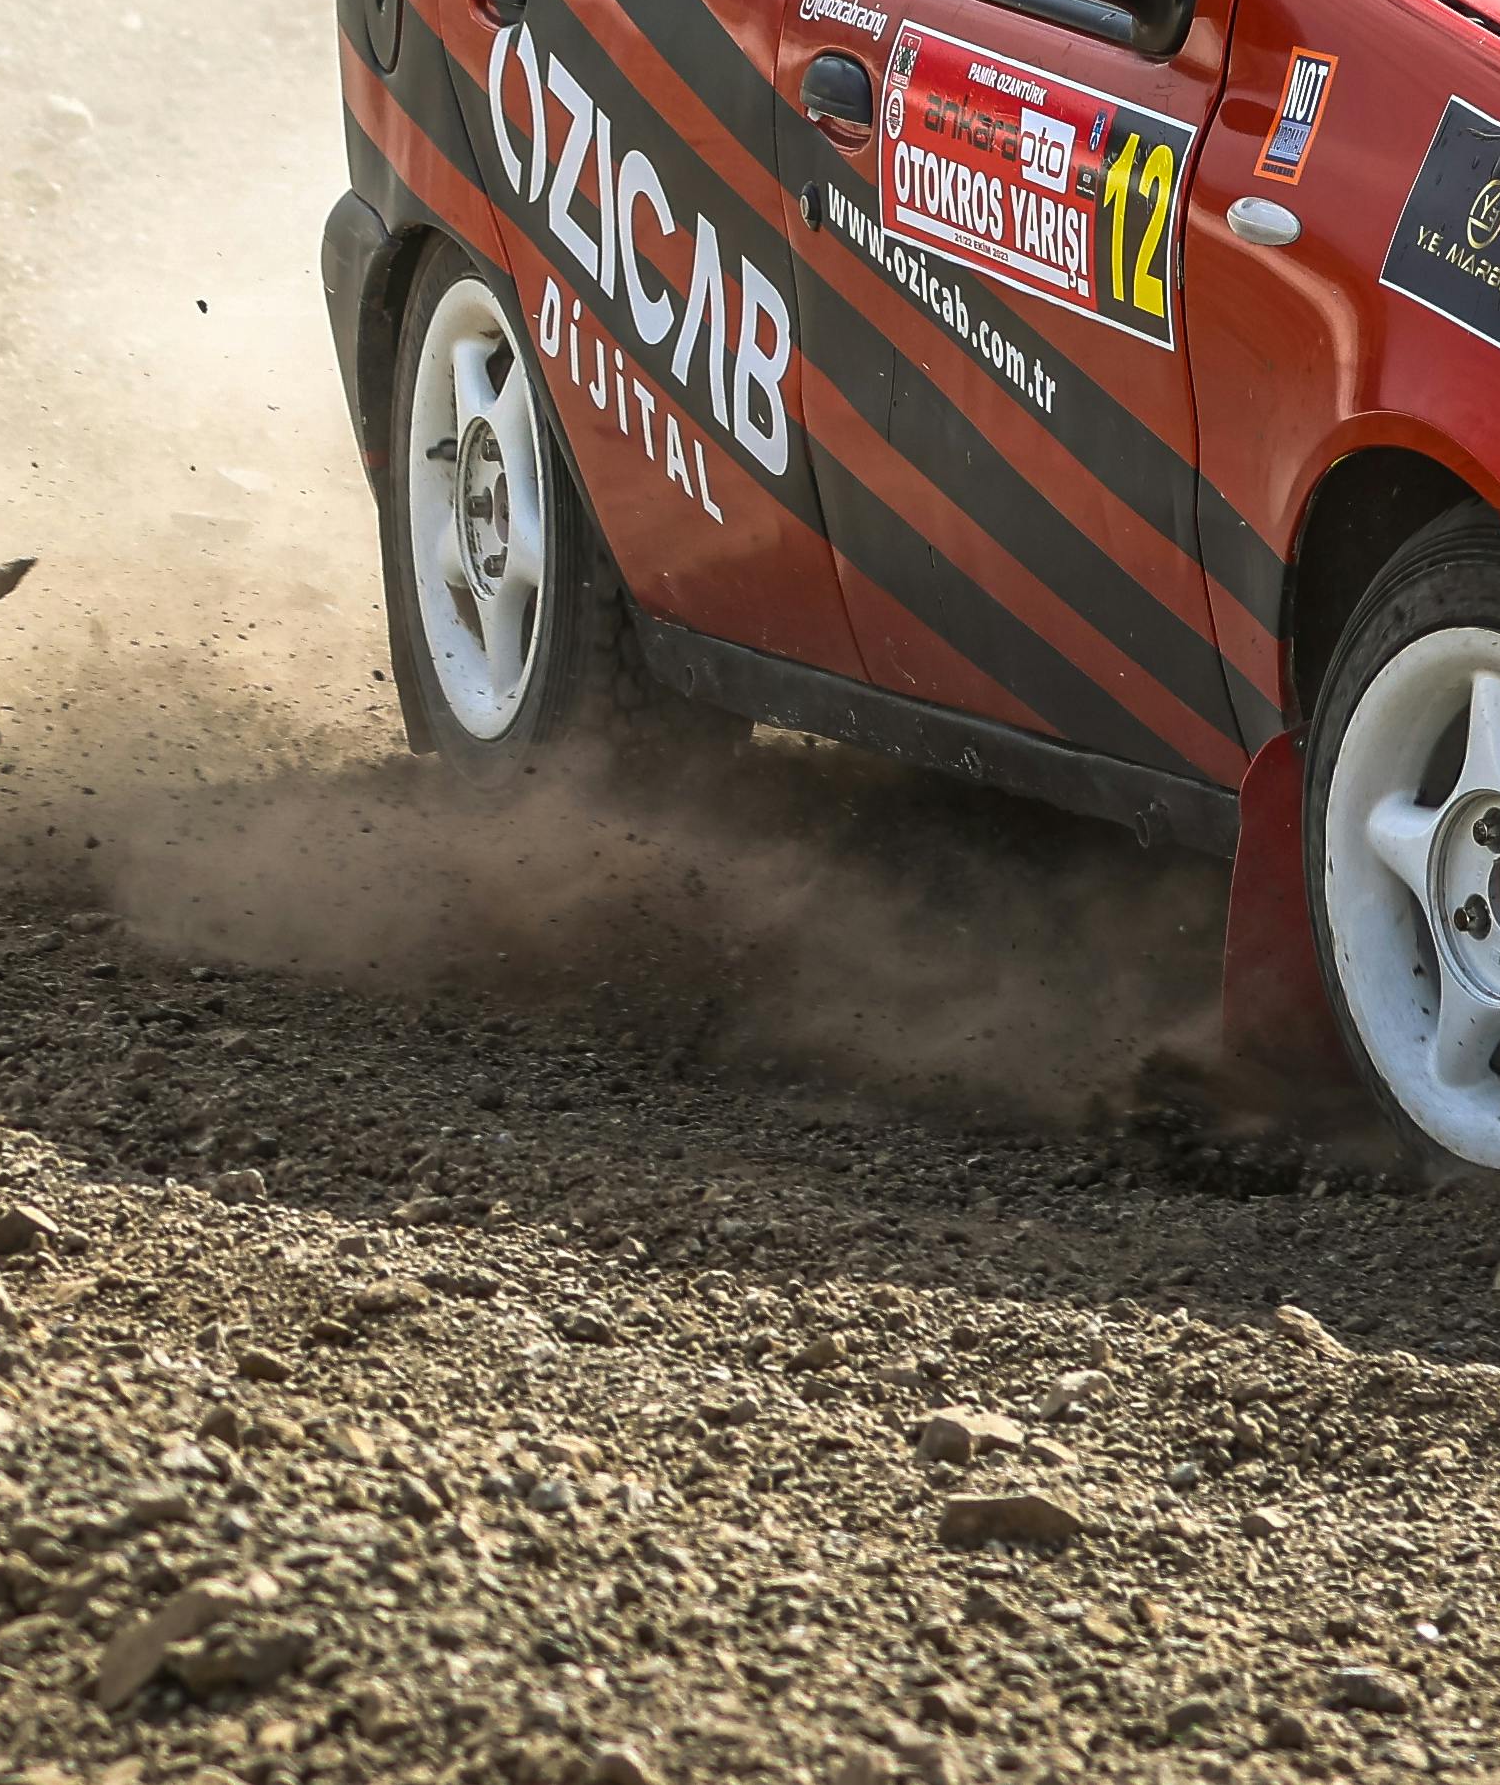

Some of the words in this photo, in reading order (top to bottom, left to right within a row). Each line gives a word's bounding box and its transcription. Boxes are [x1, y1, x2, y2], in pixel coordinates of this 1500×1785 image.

[967, 62, 997, 87] PAMİR
[997, 71, 1048, 106] OZANTÜRK
[1283, 59, 1329, 123] NOT
[488, 21, 791, 476] OZICAB
[894, 141, 1003, 241] OTOKROS
[1010, 185, 1089, 288] YARIŞI
[1104, 133, 1174, 318] 12
[828, 182, 1056, 414] www.ozicab.com.tr
